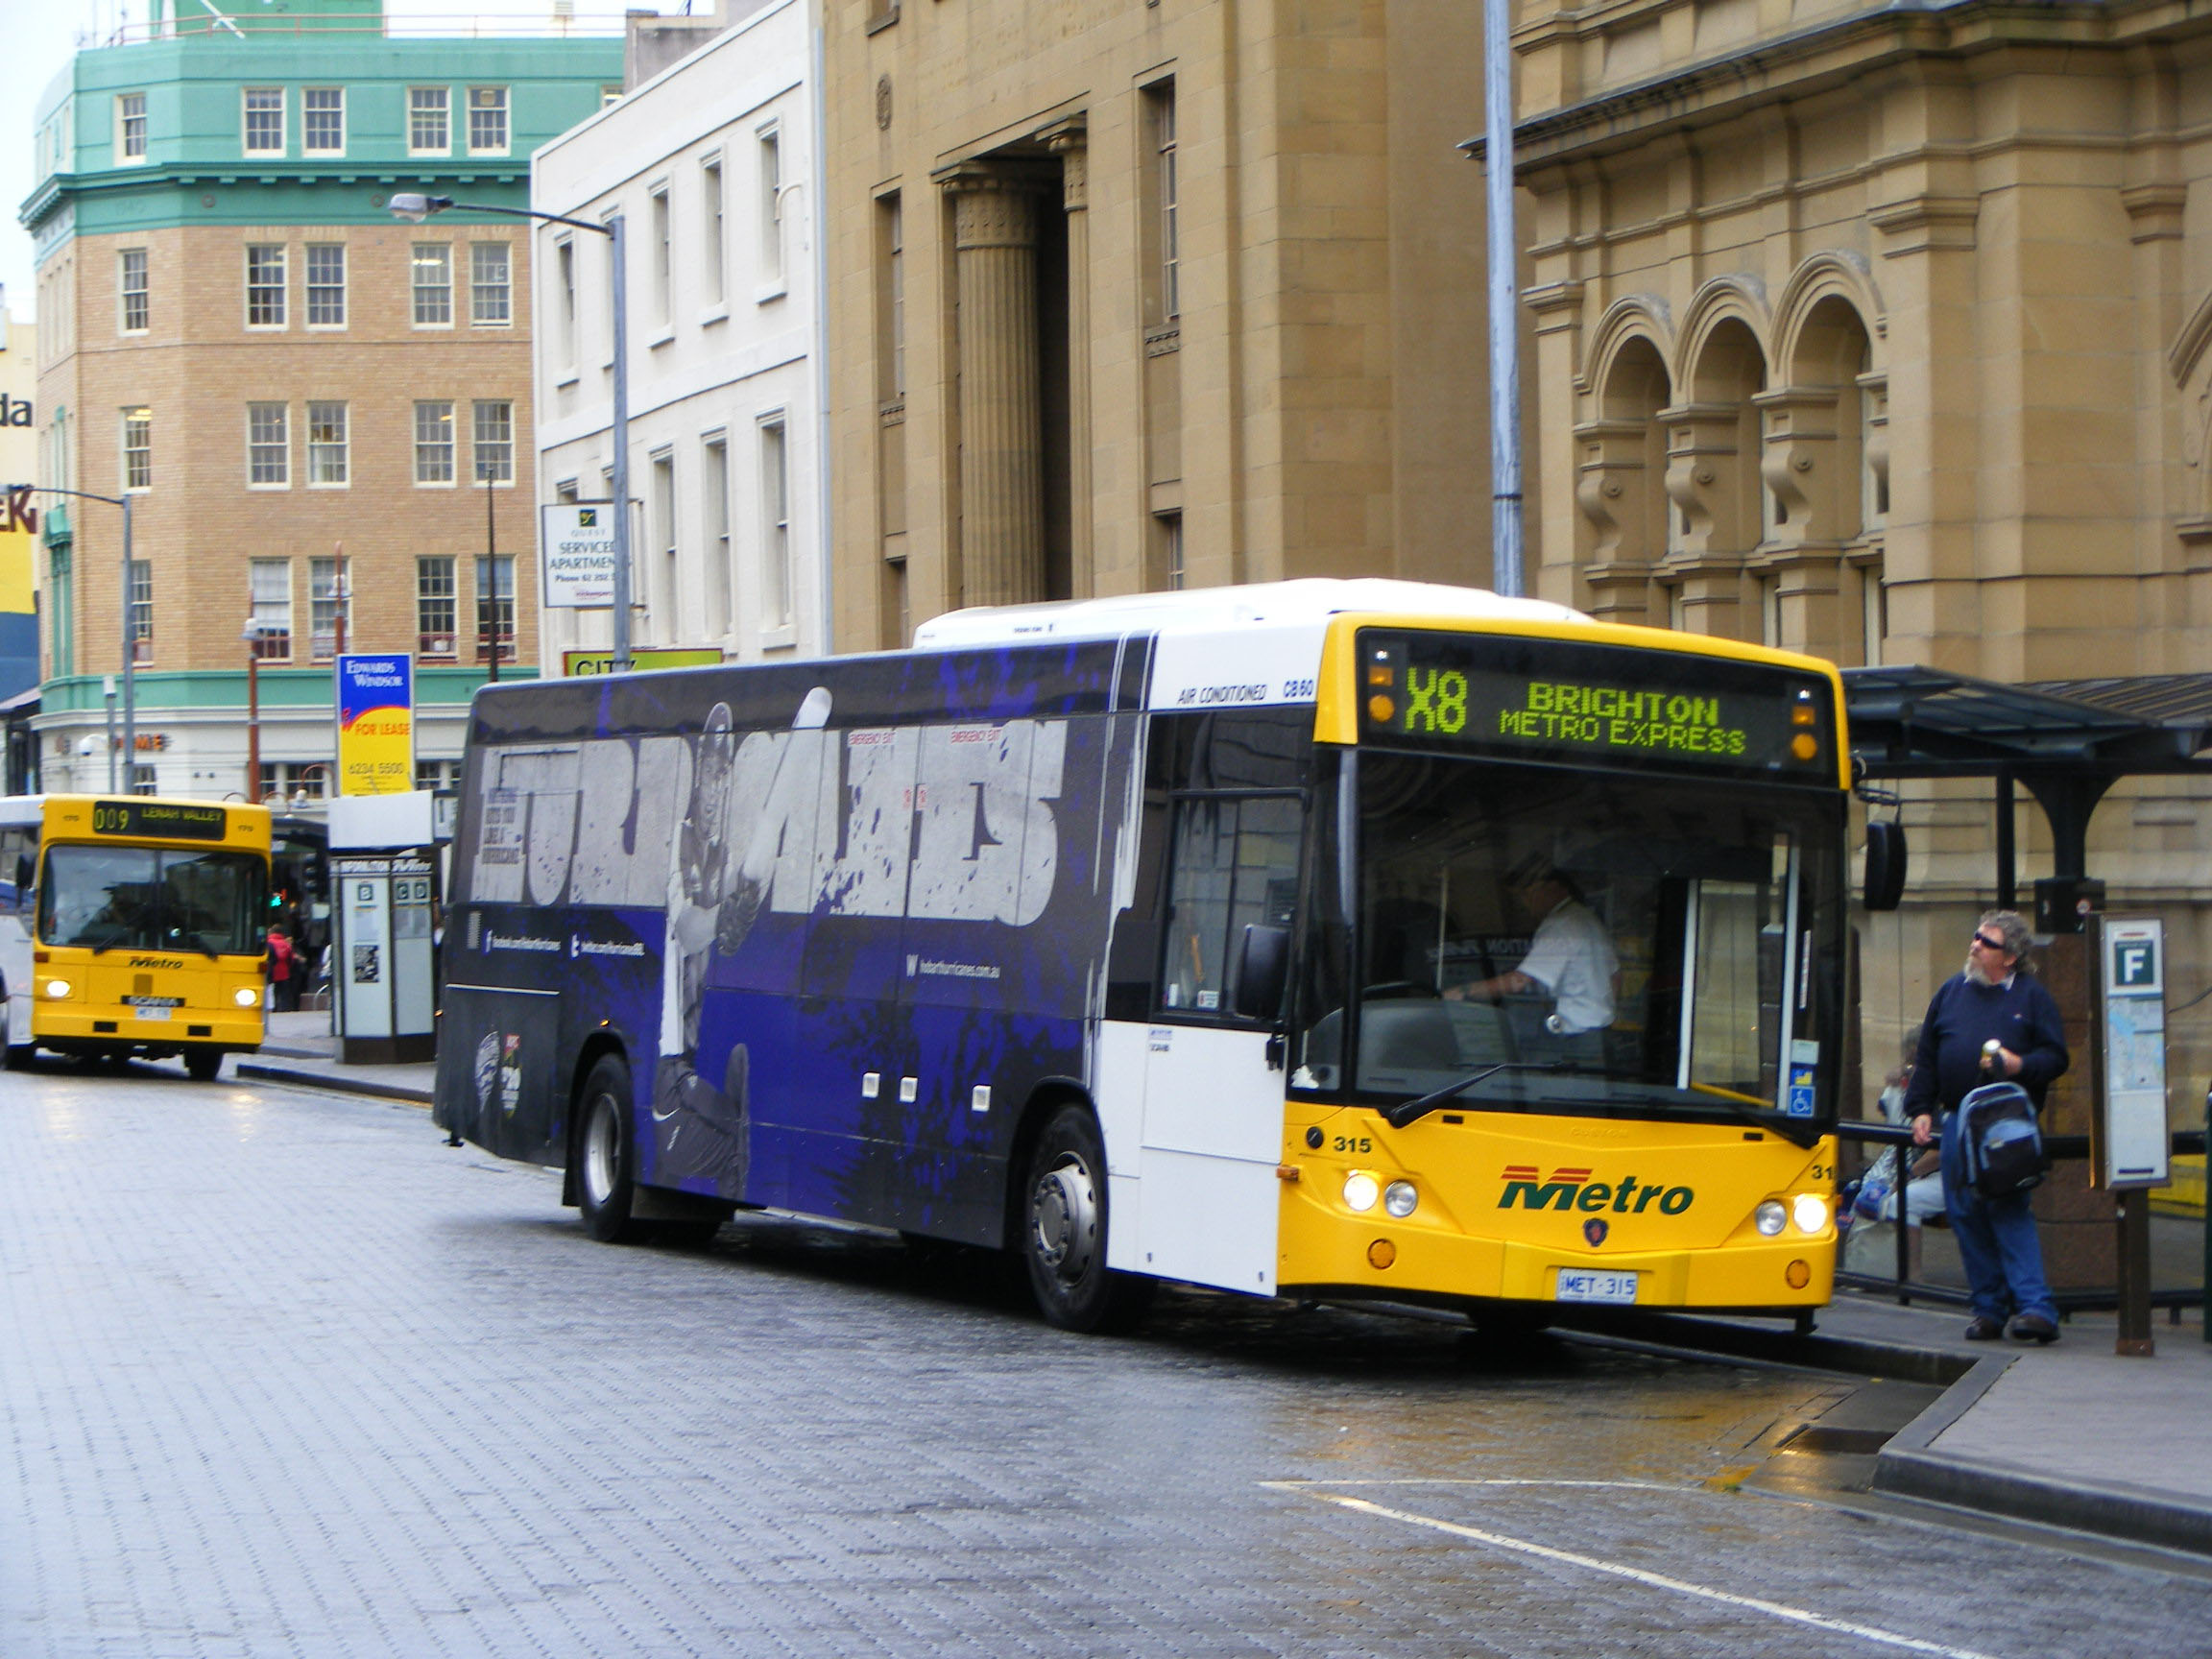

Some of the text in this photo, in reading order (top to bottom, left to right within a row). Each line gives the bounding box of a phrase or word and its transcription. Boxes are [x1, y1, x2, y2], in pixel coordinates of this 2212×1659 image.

[1177, 688, 1197, 704] AIR
[1200, 685, 1266, 703] CONDITIONED
[1406, 667, 1719, 734] X8 BRIGHTON
[355, 722, 411, 736] FOR LEASE
[1499, 709, 1747, 755] METRO EXPRESS
[96, 807, 222, 830] 009 LENAH VALLEY
[341, 860, 390, 873] INFORMATION
[129, 955, 183, 969] Metro
[2124, 949, 2147, 982] F
[1334, 1137, 1372, 1154] 315
[1497, 1165, 1695, 1216] Metro
